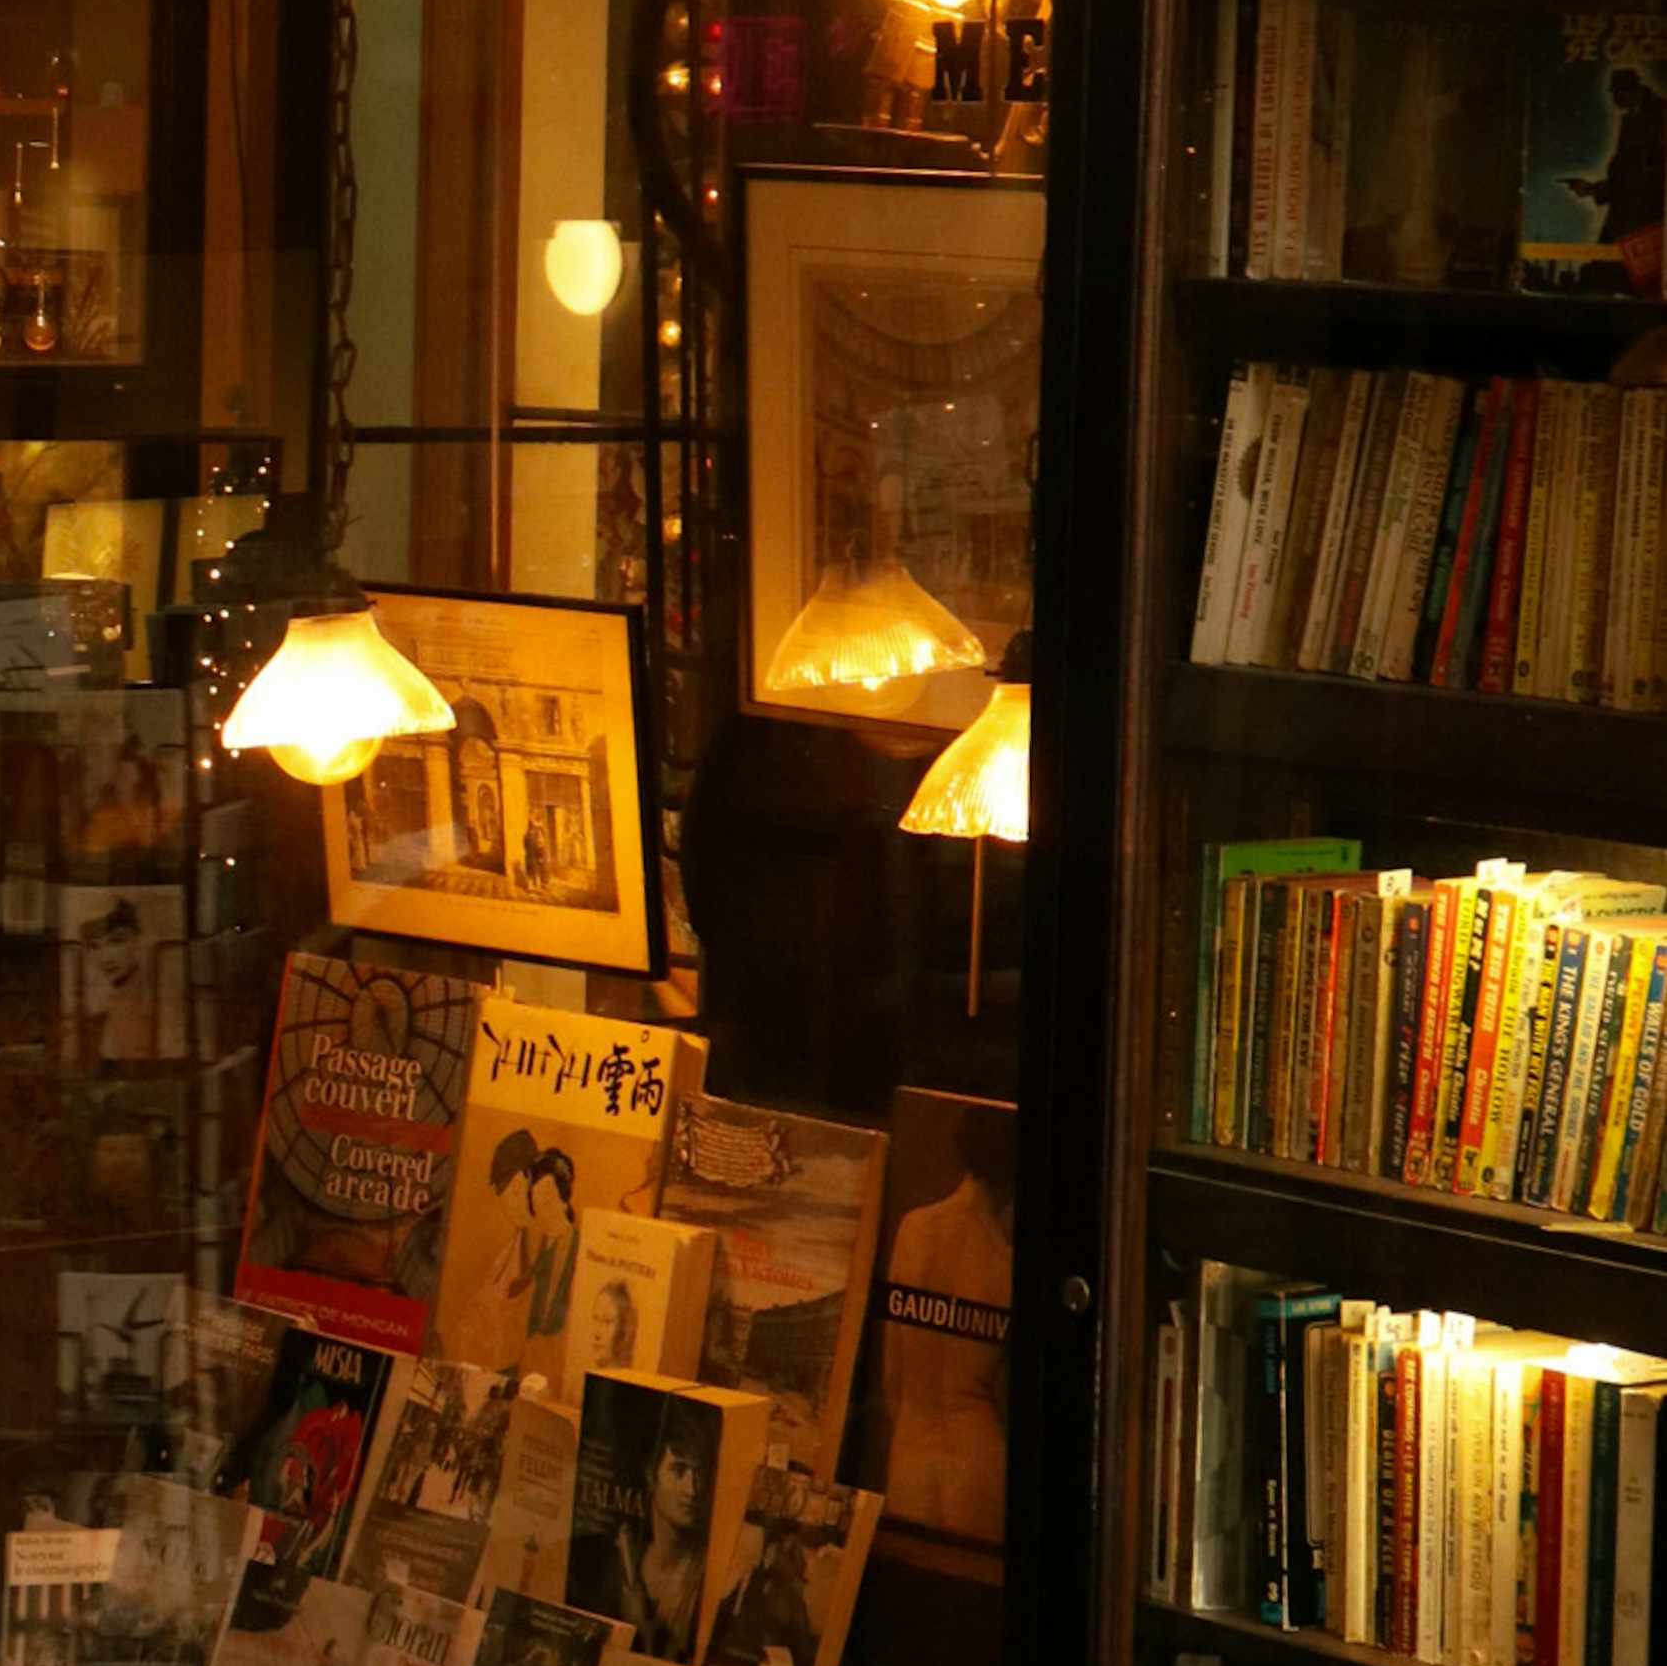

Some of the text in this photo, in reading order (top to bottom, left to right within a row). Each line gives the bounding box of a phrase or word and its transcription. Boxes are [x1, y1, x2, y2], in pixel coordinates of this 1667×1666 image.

[1436, 894, 1447, 925] THE
[1561, 965, 1577, 999] THE
[1423, 1009, 1437, 1060] DEATH
[1469, 903, 1510, 1125] THE BIG FOUR Christie
[1554, 1001, 1573, 1057] KING'S
[310, 1033, 423, 1089] Passage
[1629, 1001, 1663, 1132] WALLS OF GOLD
[304, 1075, 417, 1122] couvert
[1448, 1072, 1465, 1122] Christie
[1489, 1049, 1510, 1126] HOLLOW
[1541, 1060, 1565, 1136] GENERAL
[330, 1133, 434, 1184] Covered
[325, 1171, 432, 1214] arcade
